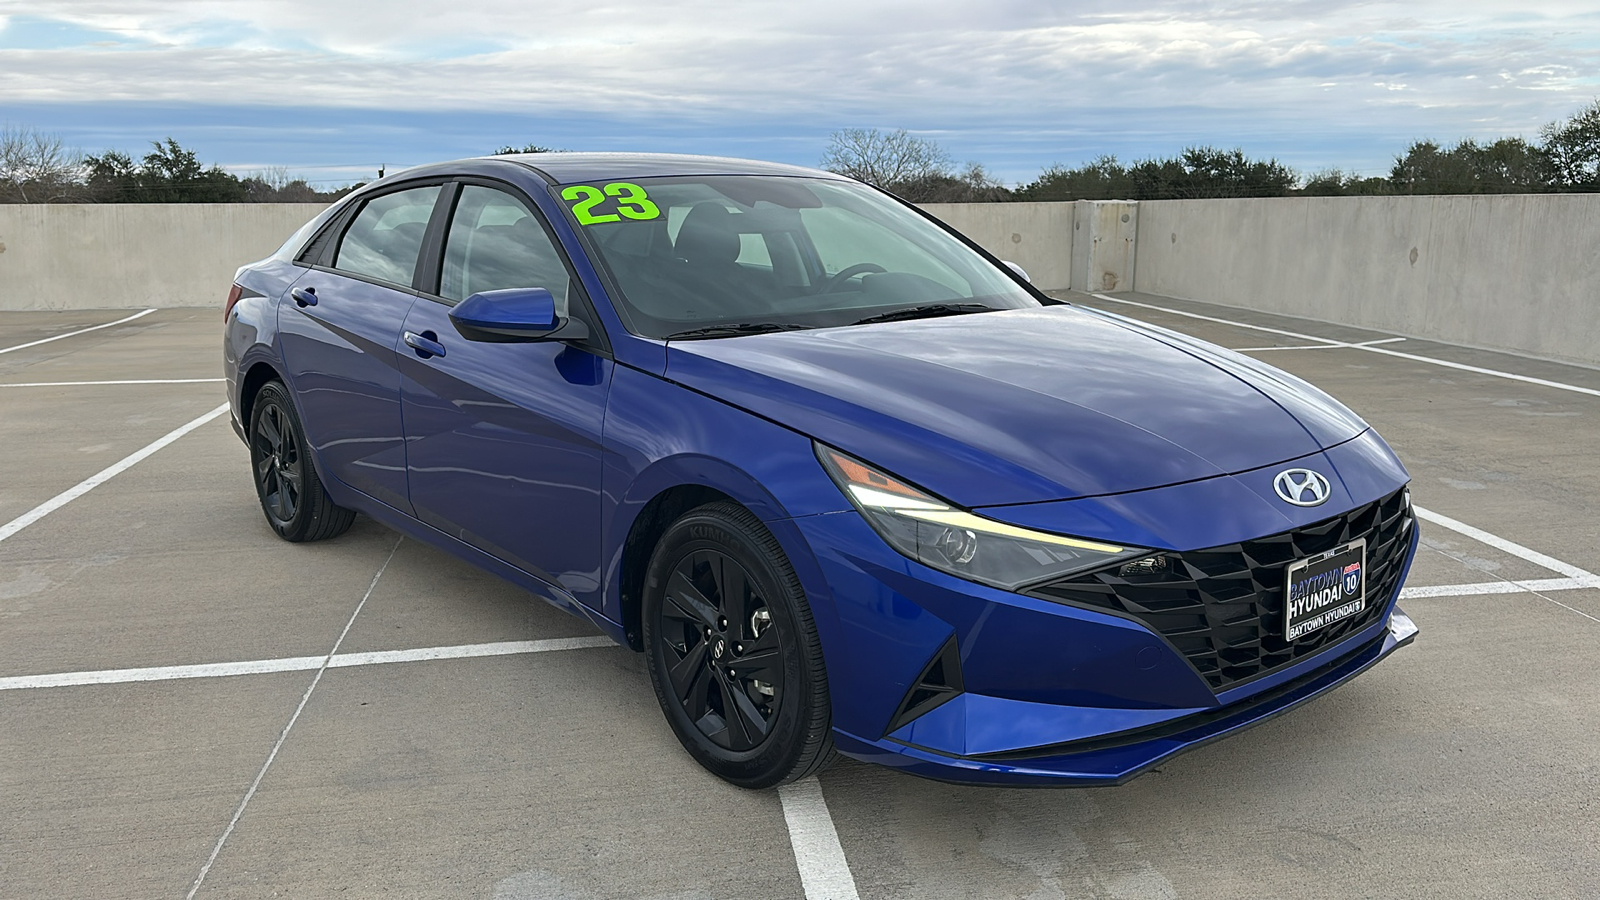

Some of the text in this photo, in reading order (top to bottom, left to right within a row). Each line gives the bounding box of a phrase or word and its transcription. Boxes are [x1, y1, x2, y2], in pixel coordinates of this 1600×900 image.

[561, 182, 660, 225] 23
[689, 526, 740, 551] KUMHO
[1291, 567, 1343, 600] BAYTOWN
[1346, 574, 1357, 591] 10
[1290, 584, 1342, 619] HYUNDAI
[1290, 617, 1324, 639] BAYTOWN
[1325, 603, 1356, 622] HYUNDAI
